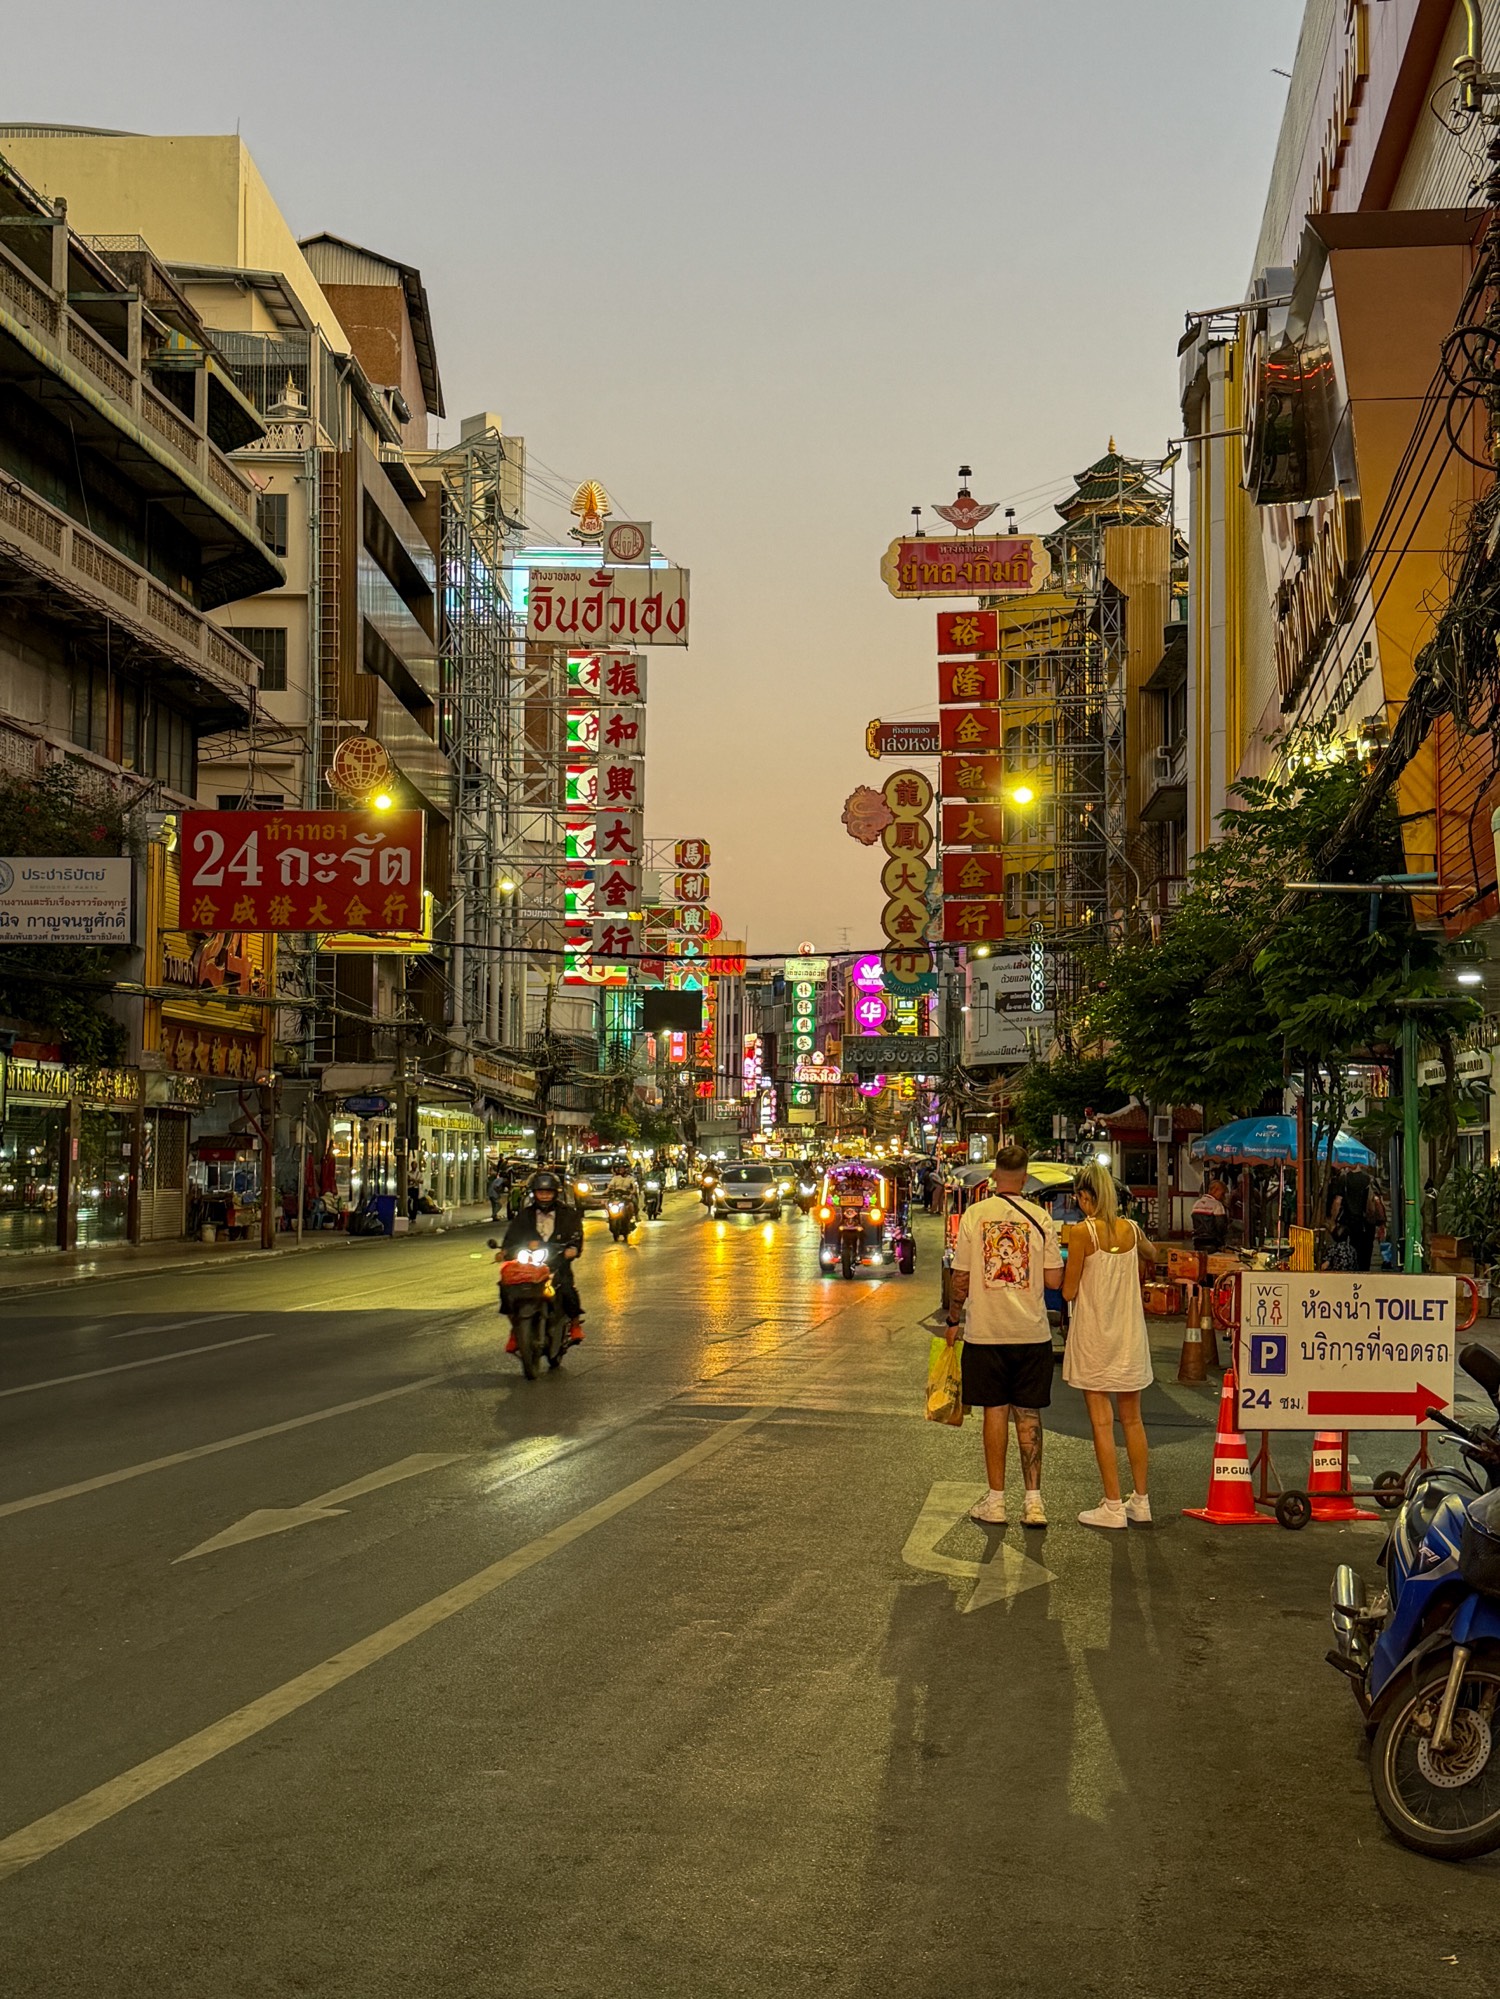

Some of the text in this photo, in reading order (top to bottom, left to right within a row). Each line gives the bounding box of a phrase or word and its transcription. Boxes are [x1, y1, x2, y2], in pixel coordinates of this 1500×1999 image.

[531, 570, 686, 635] จินฮั้วเฮง
[264, 817, 347, 841] ห้างทอง
[192, 830, 411, 887] 24 กะรัต
[21, 868, 107, 881] ประชาธิปัตย์
[27, 906, 128, 934] กาญจนชูศักดิ์
[1256, 1285, 1283, 1297] WC
[1301, 1283, 1449, 1321] ห้องน้ำ TOILET
[1260, 1341, 1279, 1369] P
[1300, 1326, 1449, 1363] บริการที่จอดรถ
[1241, 1388, 1304, 1410] 24 ชม.
